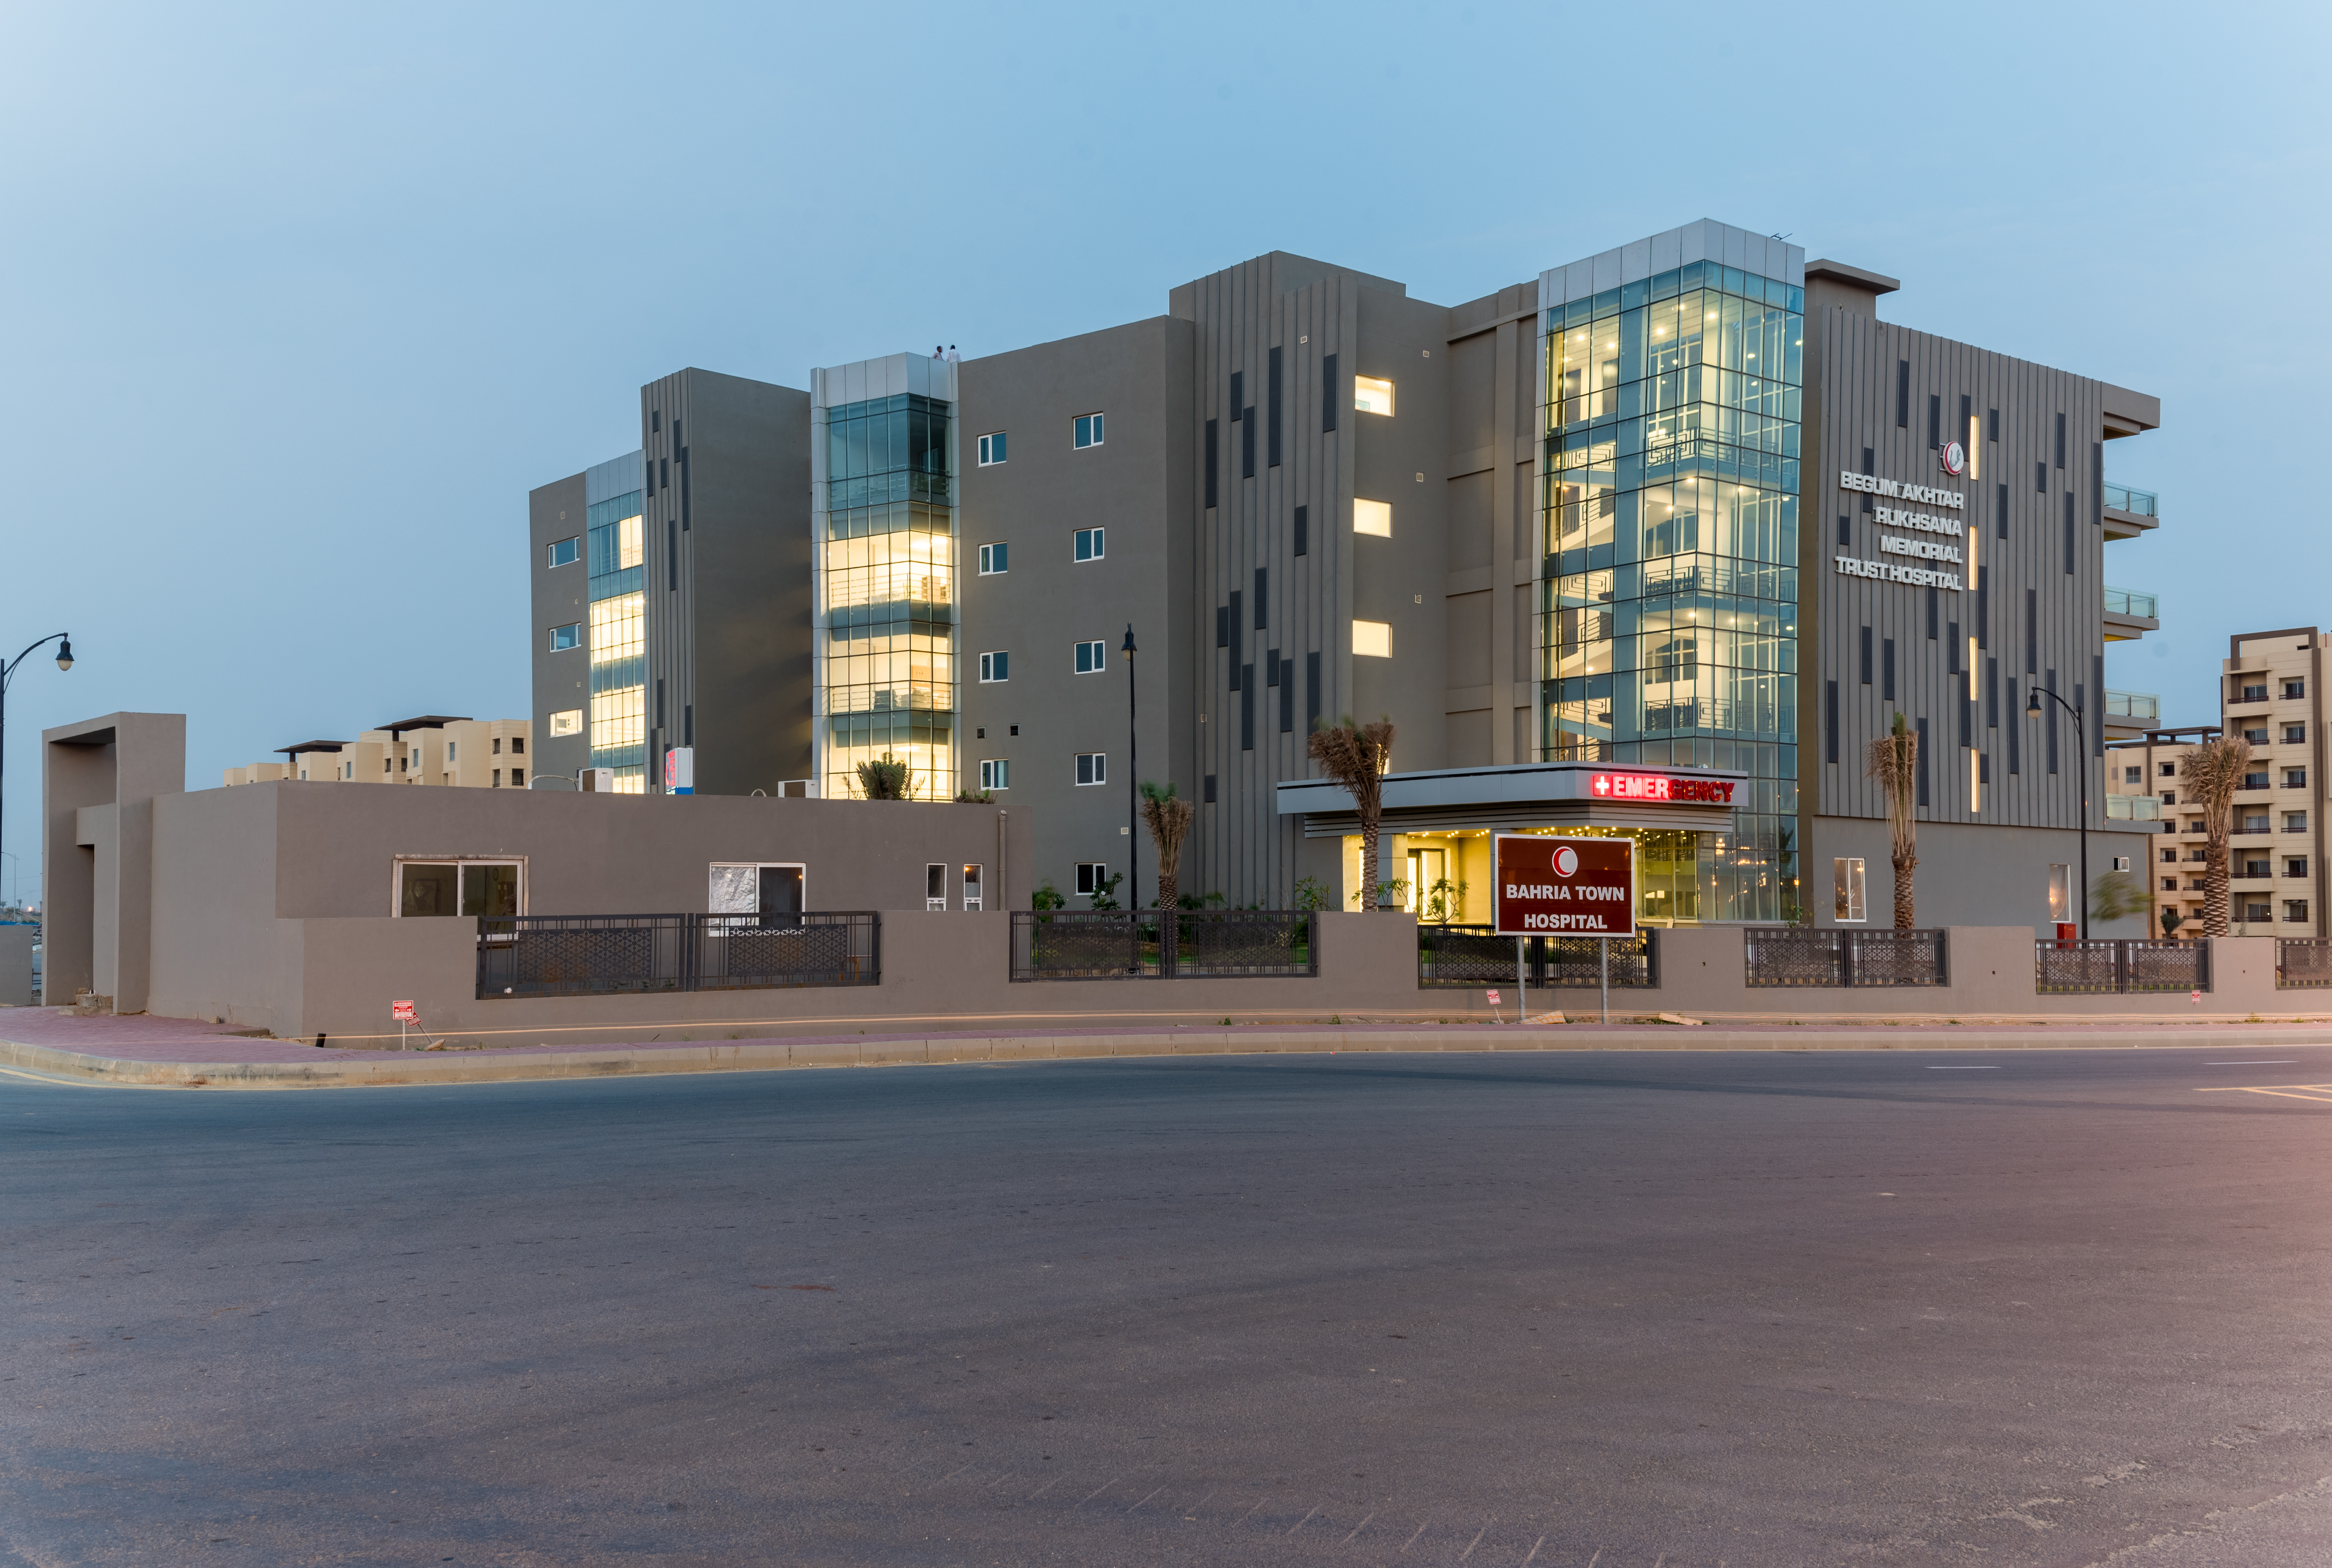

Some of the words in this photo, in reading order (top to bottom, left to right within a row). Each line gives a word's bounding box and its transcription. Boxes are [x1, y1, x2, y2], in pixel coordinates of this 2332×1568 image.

[1840, 471, 1898, 497] BEGUM
[1901, 483, 1964, 509] AKHTAR
[1875, 506, 1963, 537] RUKHSANA
[1881, 535, 1963, 564] MEMORIAL
[1835, 556, 1888, 579] TRUST
[1889, 564, 1963, 591] HOSPITAL
[1612, 775, 1735, 802] EMERGENCY
[1507, 884, 1571, 900] BAHRIA
[1575, 886, 1624, 901] TOWN
[1525, 914, 1608, 929] HOSPITAL
